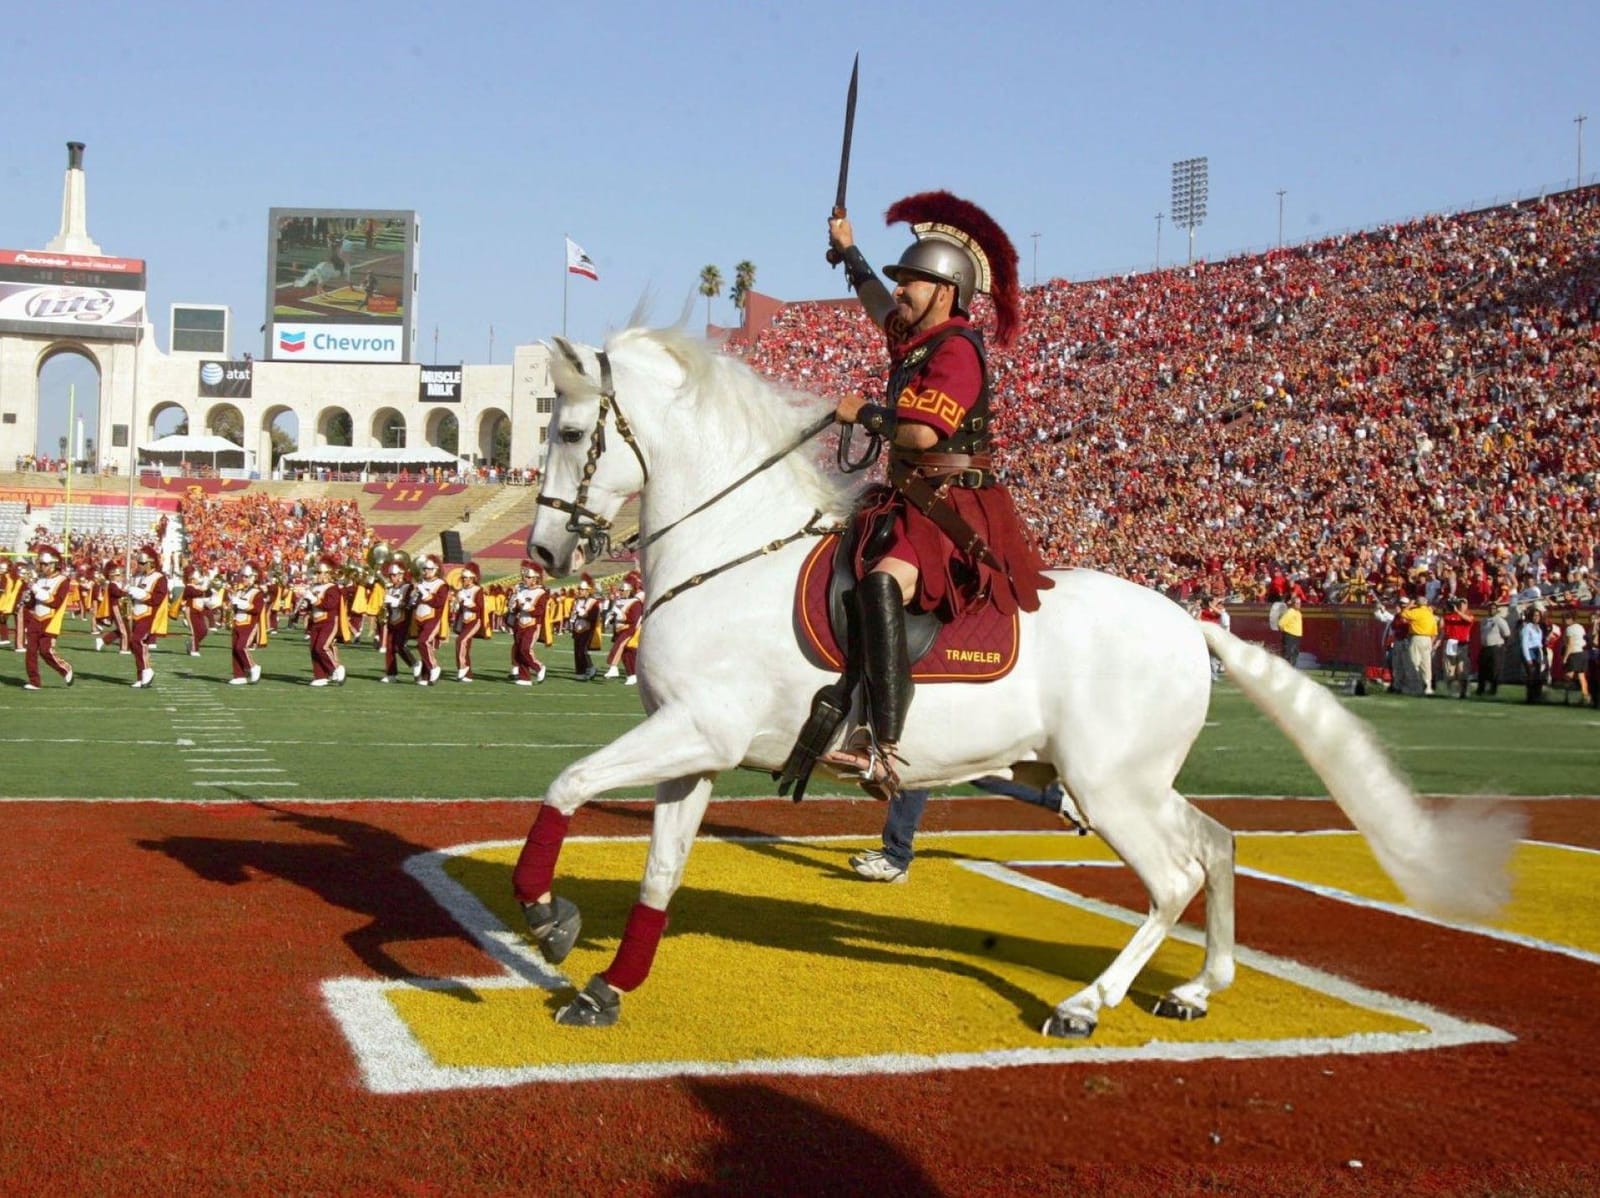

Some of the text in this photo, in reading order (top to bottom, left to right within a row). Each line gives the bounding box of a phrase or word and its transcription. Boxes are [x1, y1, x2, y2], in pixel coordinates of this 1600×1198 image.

[31, 296, 110, 318] Lite
[313, 333, 395, 351] Chevron
[421, 370, 461, 383] MUSCLE
[427, 383, 455, 396] MILK
[393, 489, 424, 501] 11
[945, 649, 1001, 664] TRAVELER
